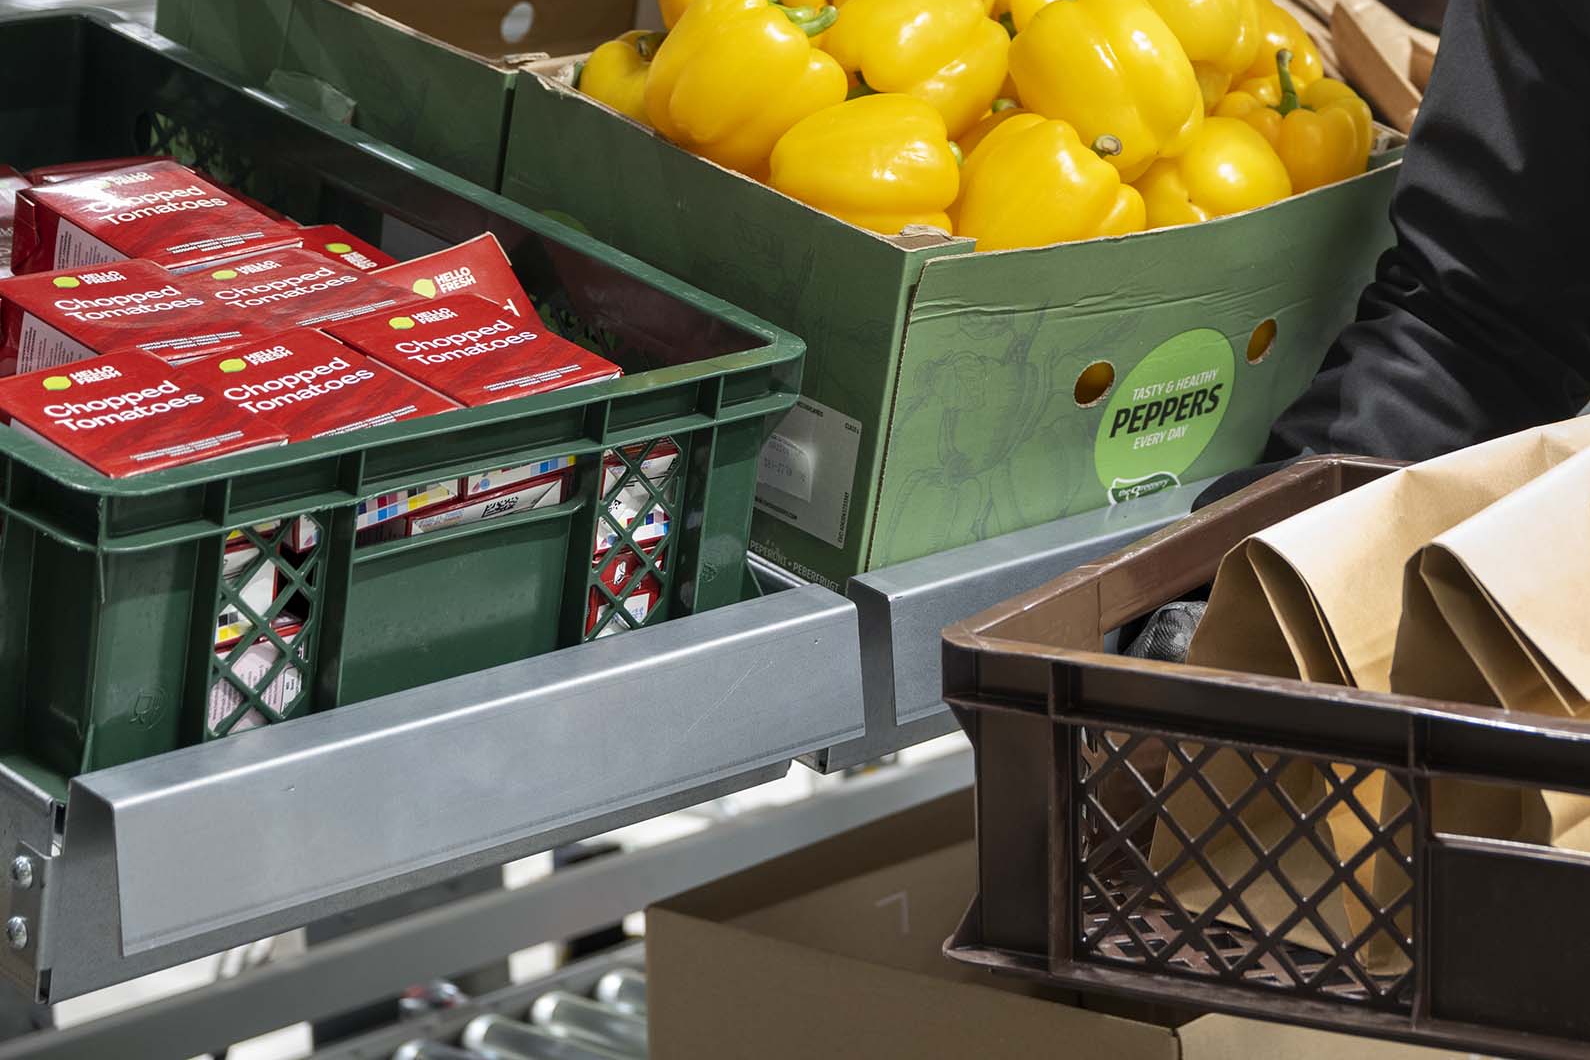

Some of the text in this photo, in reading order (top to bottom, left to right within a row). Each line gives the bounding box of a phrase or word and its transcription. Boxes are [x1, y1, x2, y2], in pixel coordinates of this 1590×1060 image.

[98, 196, 228, 226] Tomatoes
[215, 266, 336, 300] Chopped
[225, 275, 358, 309] Tomatoes
[434, 266, 471, 285] HELLO
[439, 275, 477, 294] FRESH
[54, 285, 182, 311] Chopped
[64, 297, 204, 322] Tomatoes
[243, 345, 286, 362] HELLO
[395, 320, 514, 354] Chopped
[407, 331, 537, 365] Tomatoes
[69, 365, 116, 381] HELLO
[223, 357, 351, 401] Chopped
[1132, 368, 1219, 402] TASTY & HEALTHY
[43, 380, 181, 418] Chopped
[238, 368, 375, 414] Tomatoes
[54, 393, 205, 432] Tomatoes
[1109, 383, 1224, 438] PEPPERS
[1133, 425, 1189, 450] EVERY DAY
[792, 562, 839, 592] PEBERFRUGT
